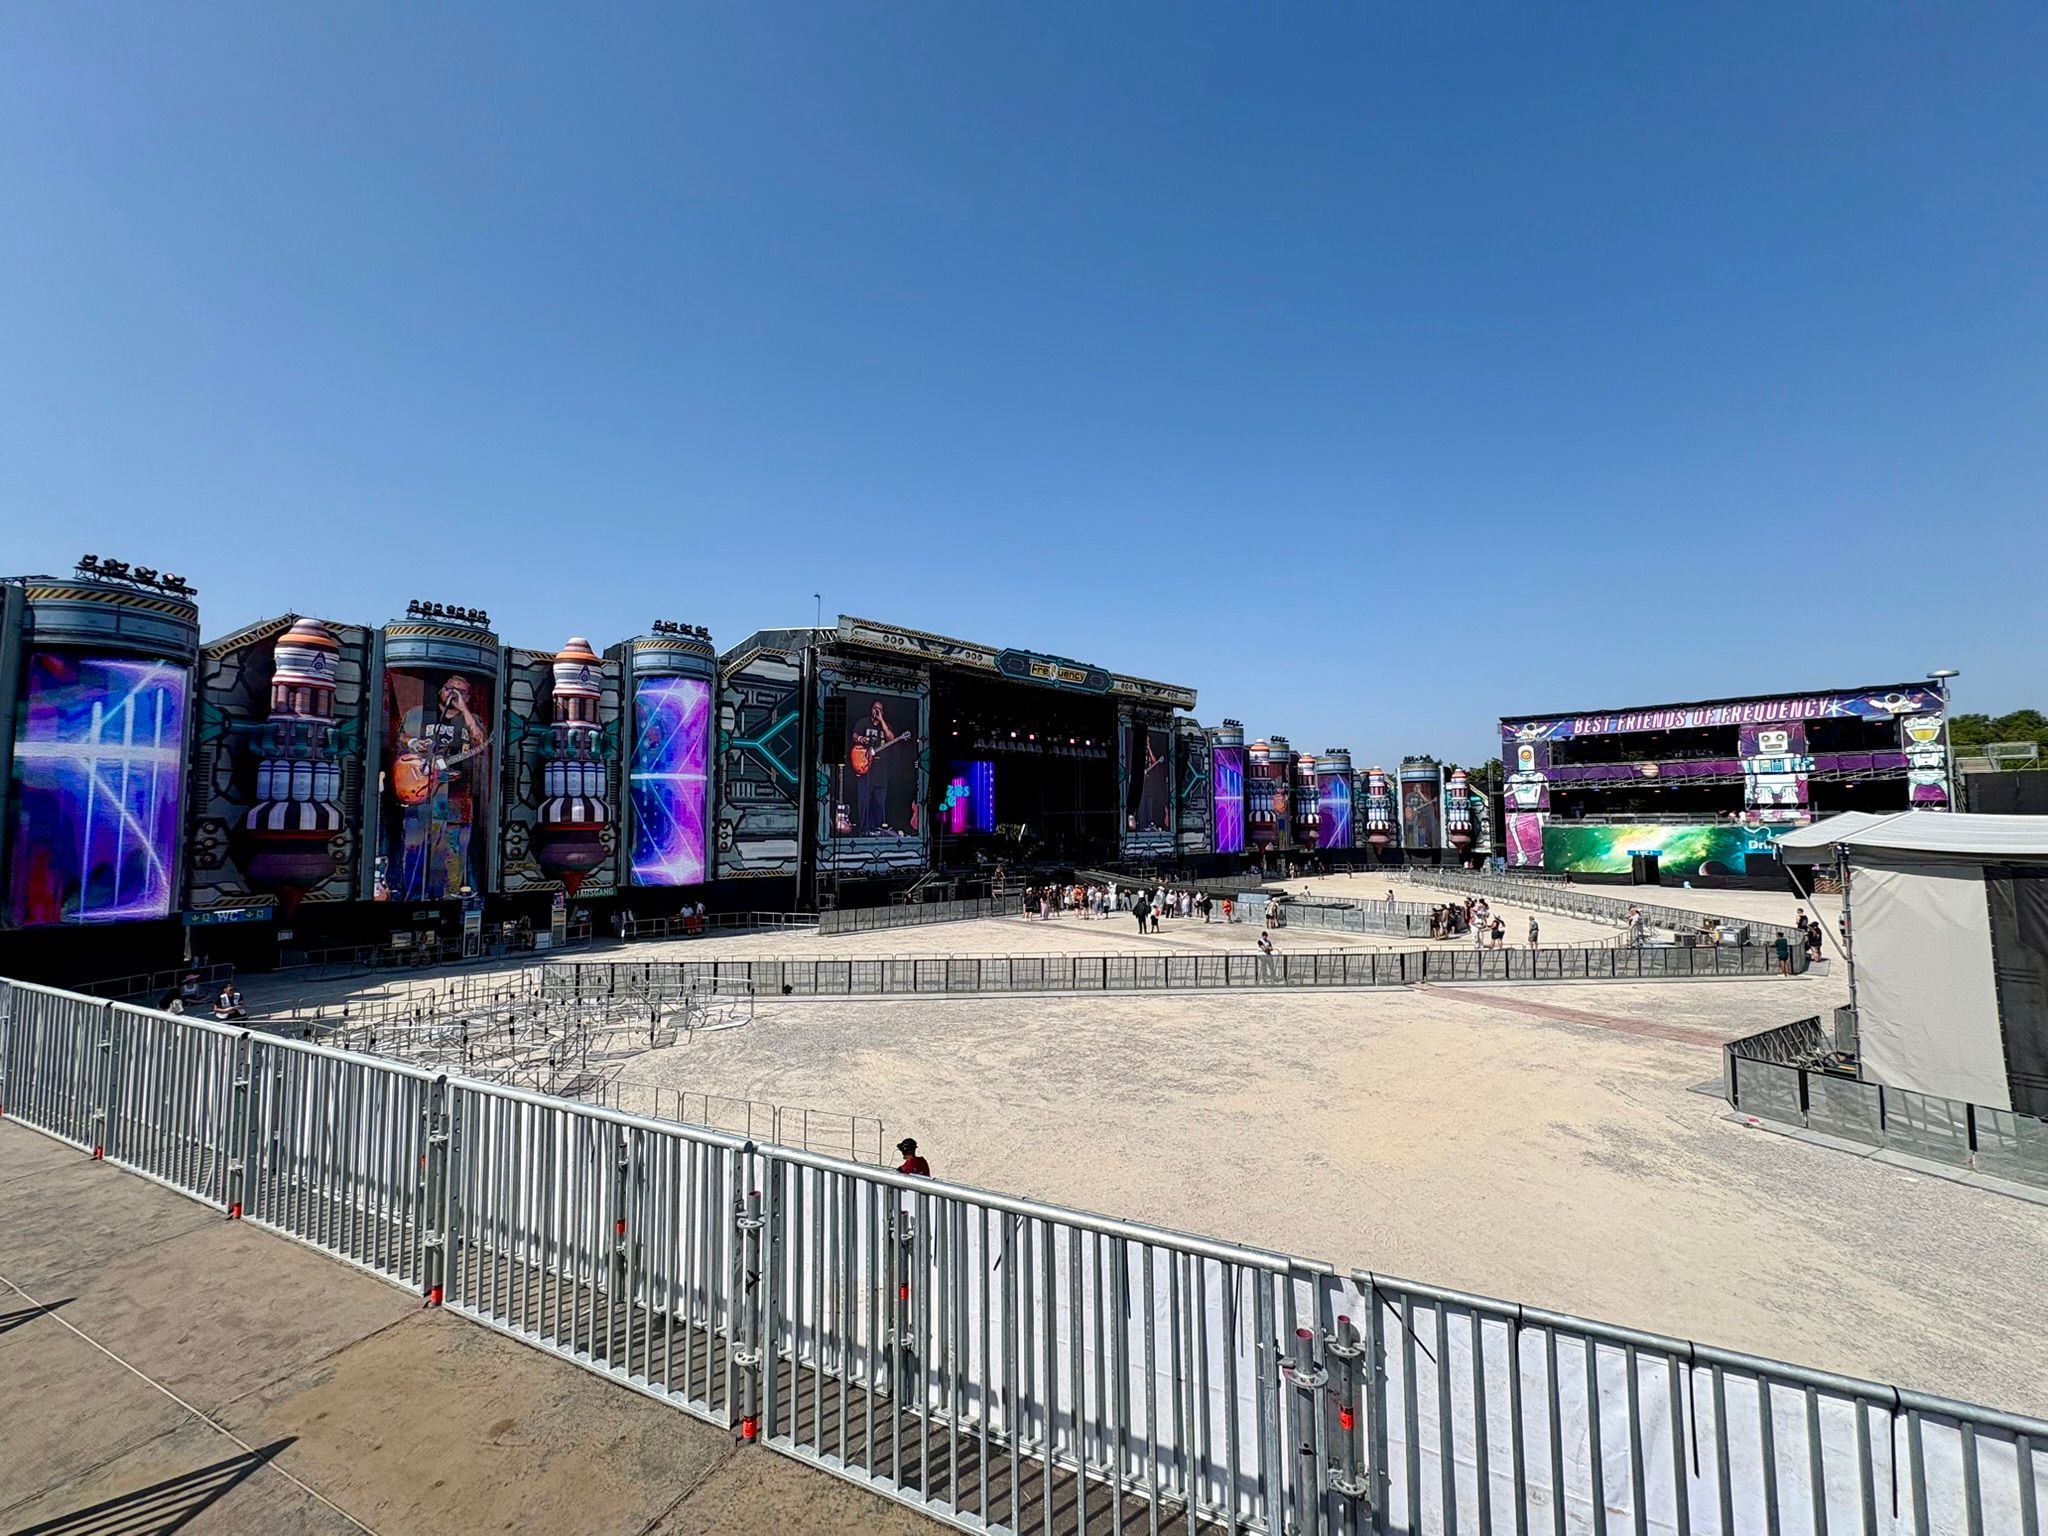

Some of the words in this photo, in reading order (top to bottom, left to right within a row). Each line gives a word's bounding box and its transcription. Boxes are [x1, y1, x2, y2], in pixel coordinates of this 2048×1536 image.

[1574, 717, 1610, 735] BEST
[1616, 708, 1687, 732] FRIENDS
[1693, 706, 1714, 726] OF
[1720, 697, 1830, 724] FREQUENCY
[217, 912, 239, 922] WC
